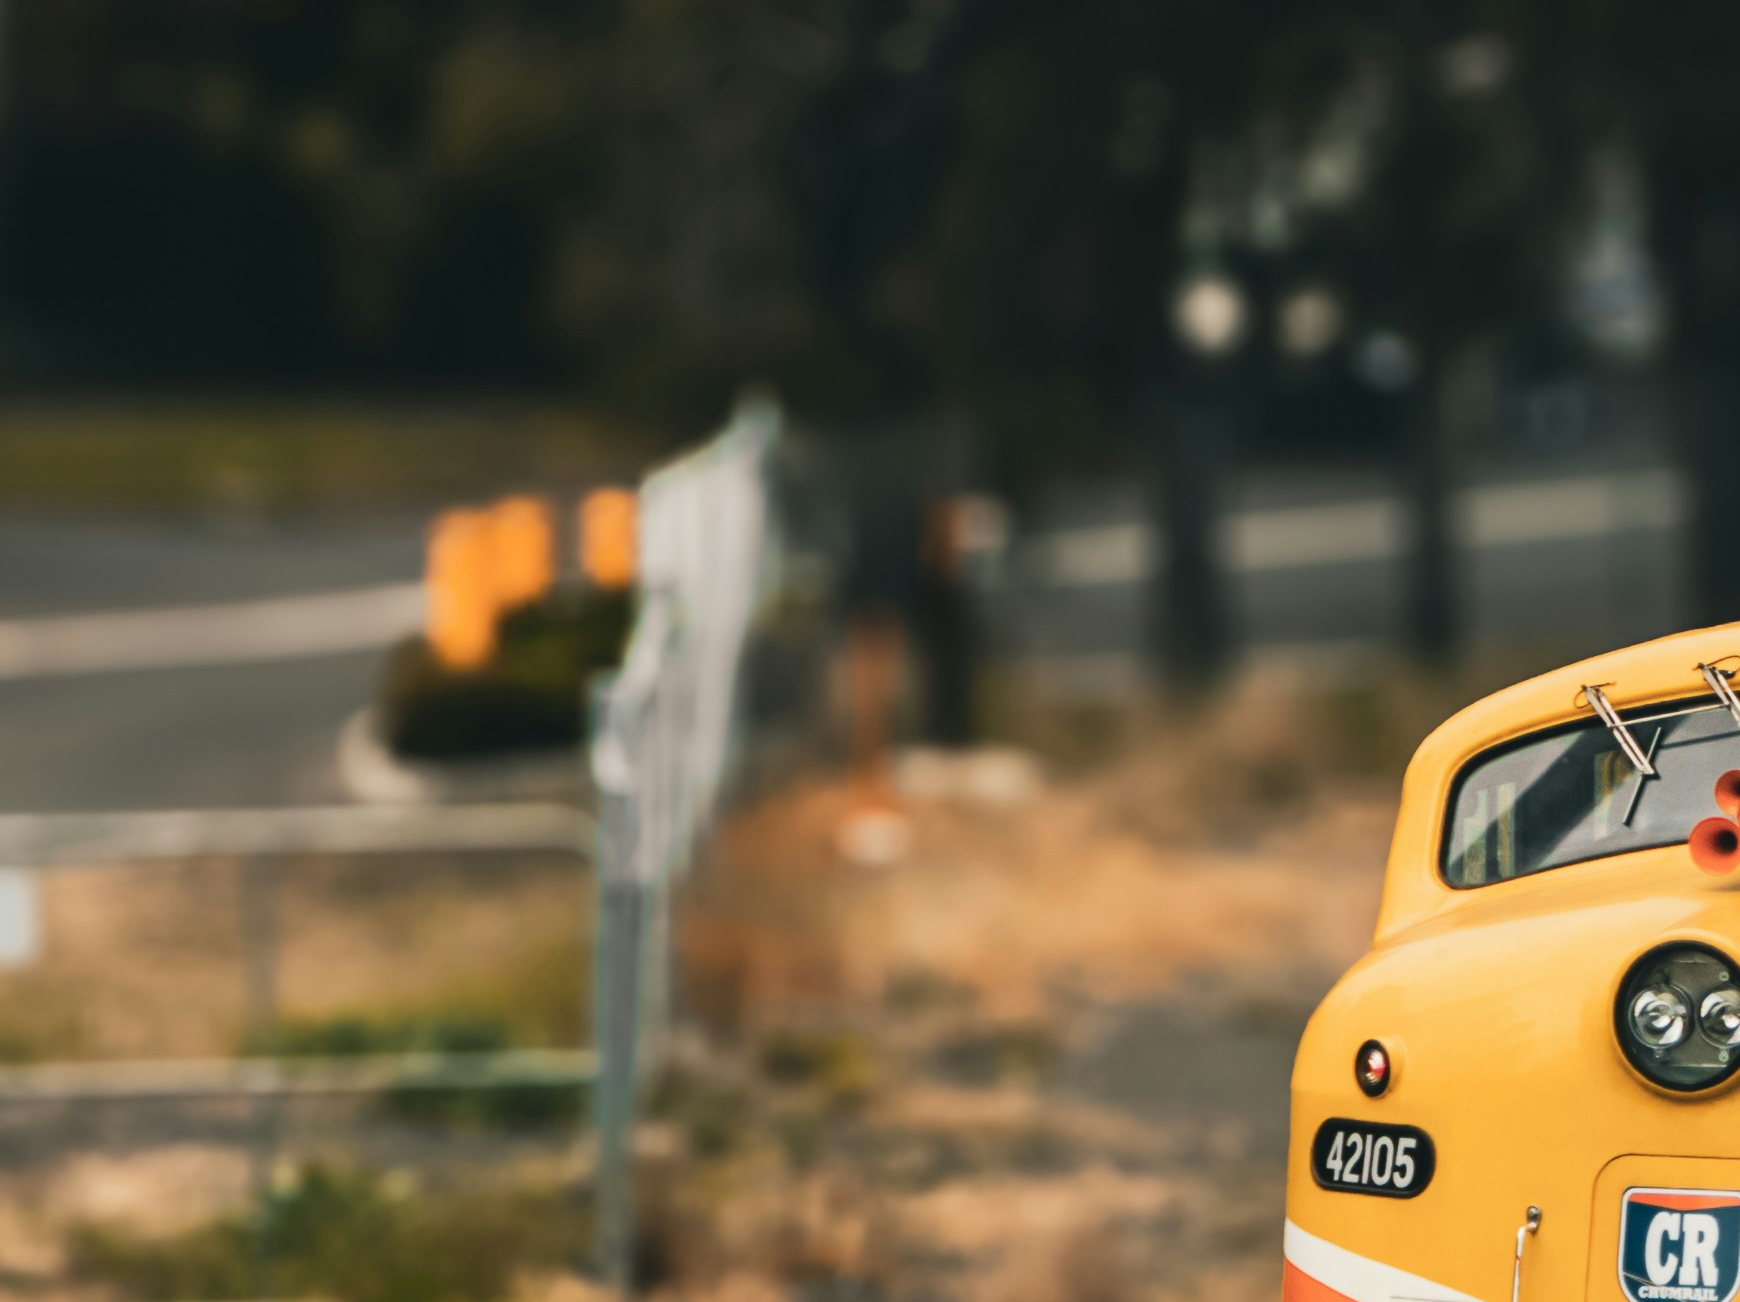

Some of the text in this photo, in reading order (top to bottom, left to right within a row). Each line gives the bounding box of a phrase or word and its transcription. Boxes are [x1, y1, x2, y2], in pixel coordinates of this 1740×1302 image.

[1326, 1131, 1417, 1188] 42105
[1644, 1210, 1720, 1287] CR
[1638, 1285, 1719, 1302] CHUMRAIL
